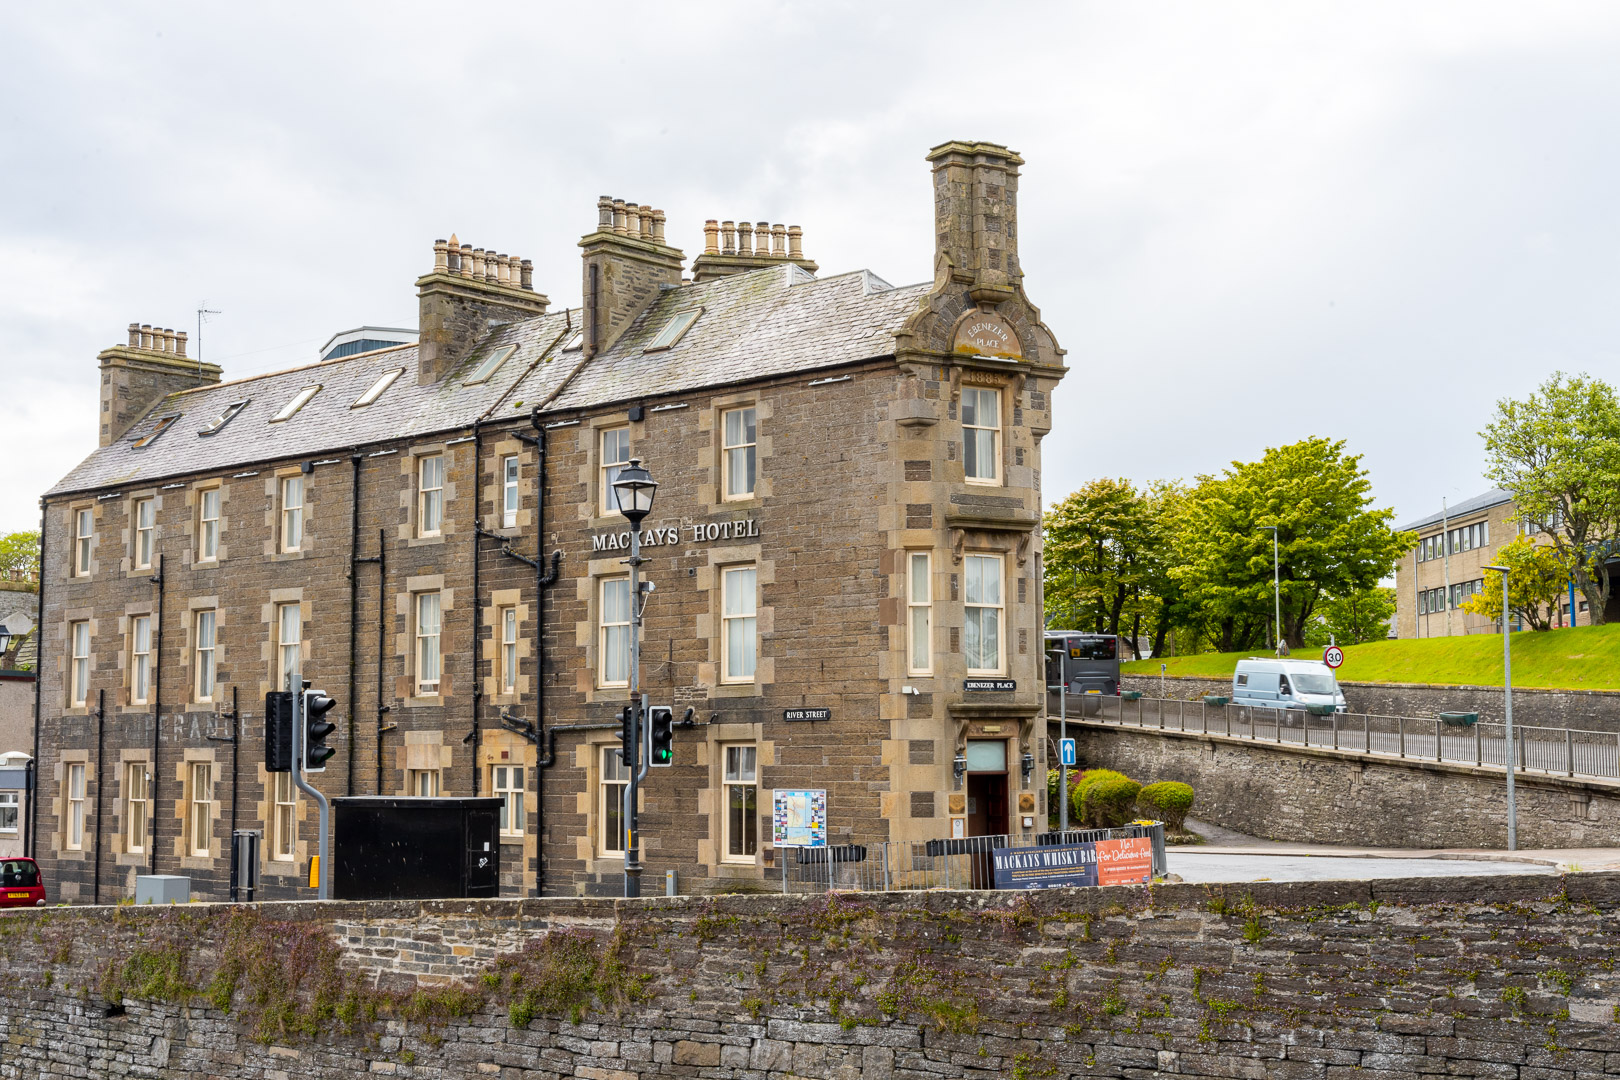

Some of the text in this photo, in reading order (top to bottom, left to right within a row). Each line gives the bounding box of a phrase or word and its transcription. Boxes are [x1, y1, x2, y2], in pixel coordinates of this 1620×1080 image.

[967, 322, 1008, 342] EBENEZER
[976, 337, 999, 348] PLACE
[693, 519, 759, 542] HOTEL
[1328, 652, 1341, 662] 30
[786, 710, 827, 719] RIVER STREET
[995, 849, 1097, 869] MACKAYS WHISKY BAR
[1097, 851, 1111, 862] for
[1112, 849, 1139, 861] Delicious
